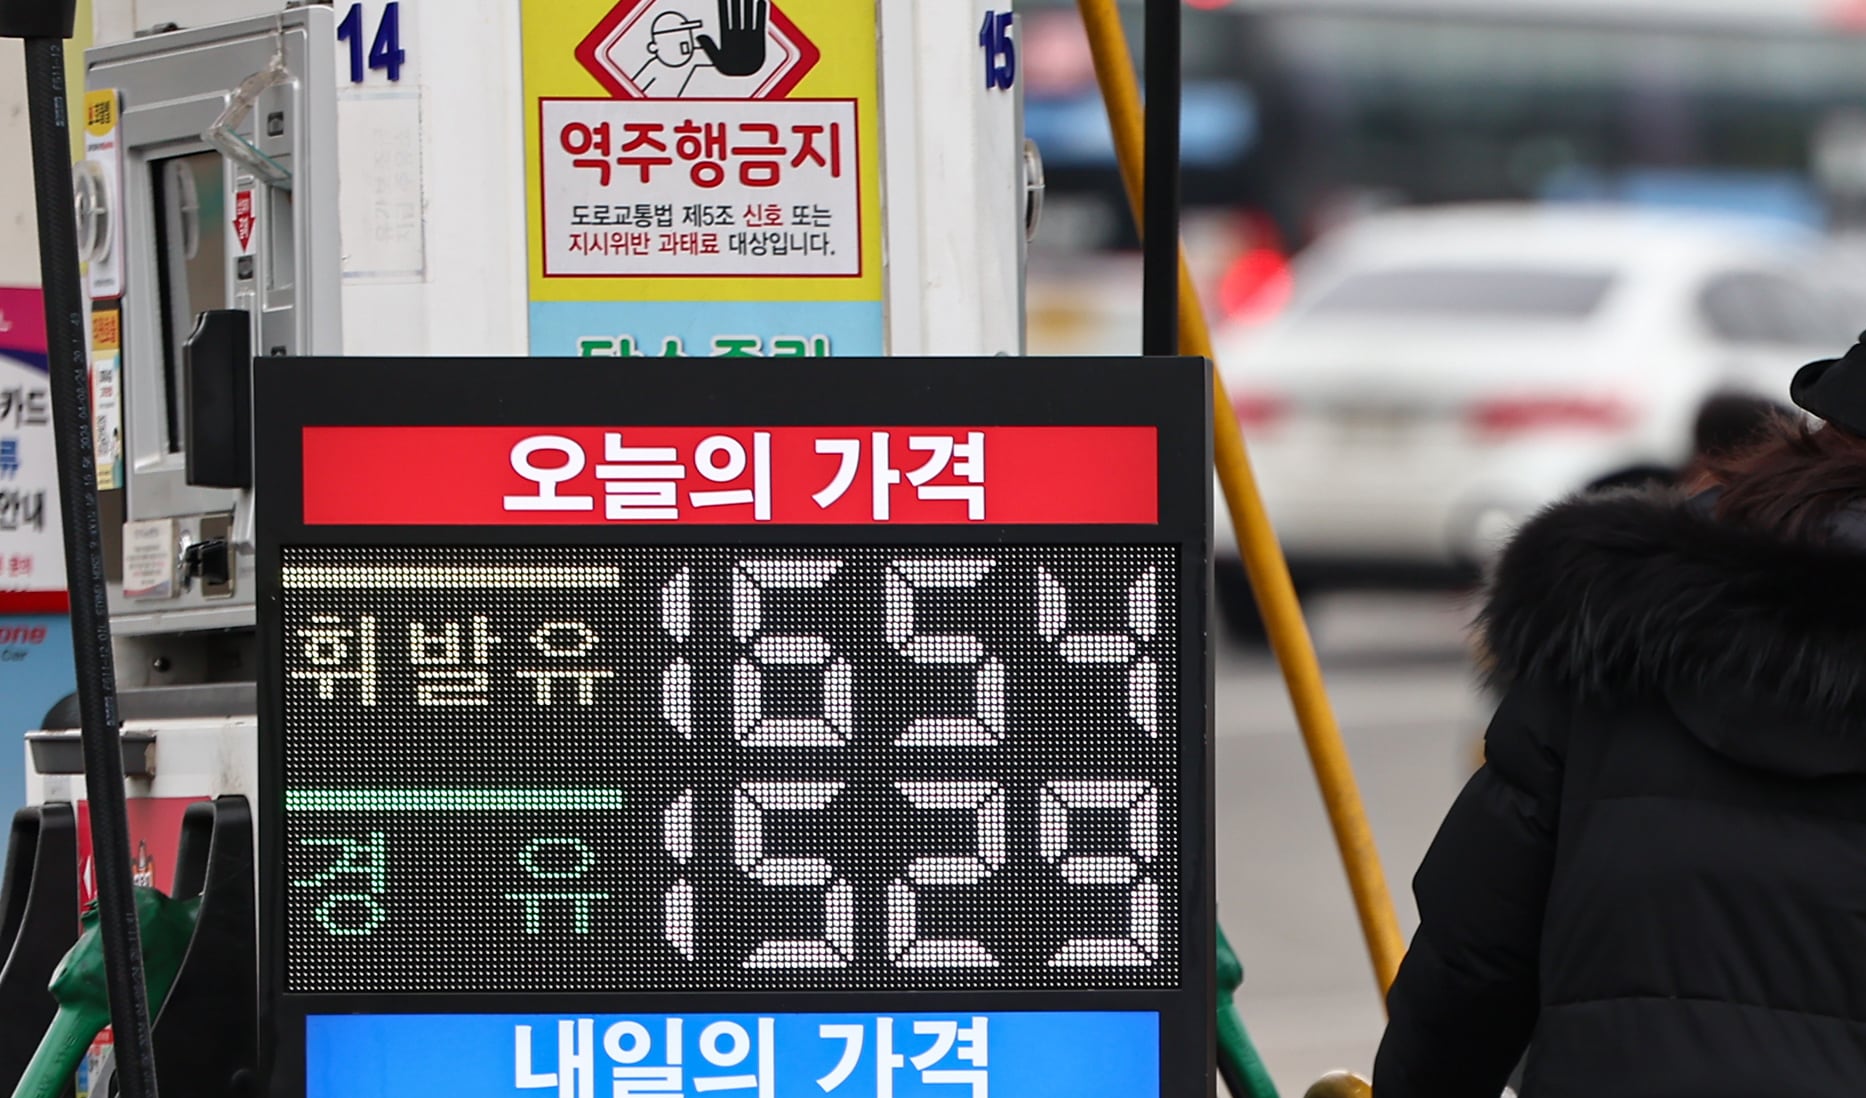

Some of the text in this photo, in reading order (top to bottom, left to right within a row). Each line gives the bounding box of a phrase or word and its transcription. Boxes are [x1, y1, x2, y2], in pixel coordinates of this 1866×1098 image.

[337, 2, 405, 83] 14
[979, 10, 1016, 90] 15
[560, 118, 842, 188] 역주행금지
[569, 231, 836, 257] 지시위반 과태료 대상입니다.
[571, 203, 831, 228] 도로교통법 제5조 신호 또는
[503, 431, 987, 520] 오늘의 가격
[289, 558, 1160, 748] 휘발유 1654
[291, 780, 1160, 969] 경유 1529
